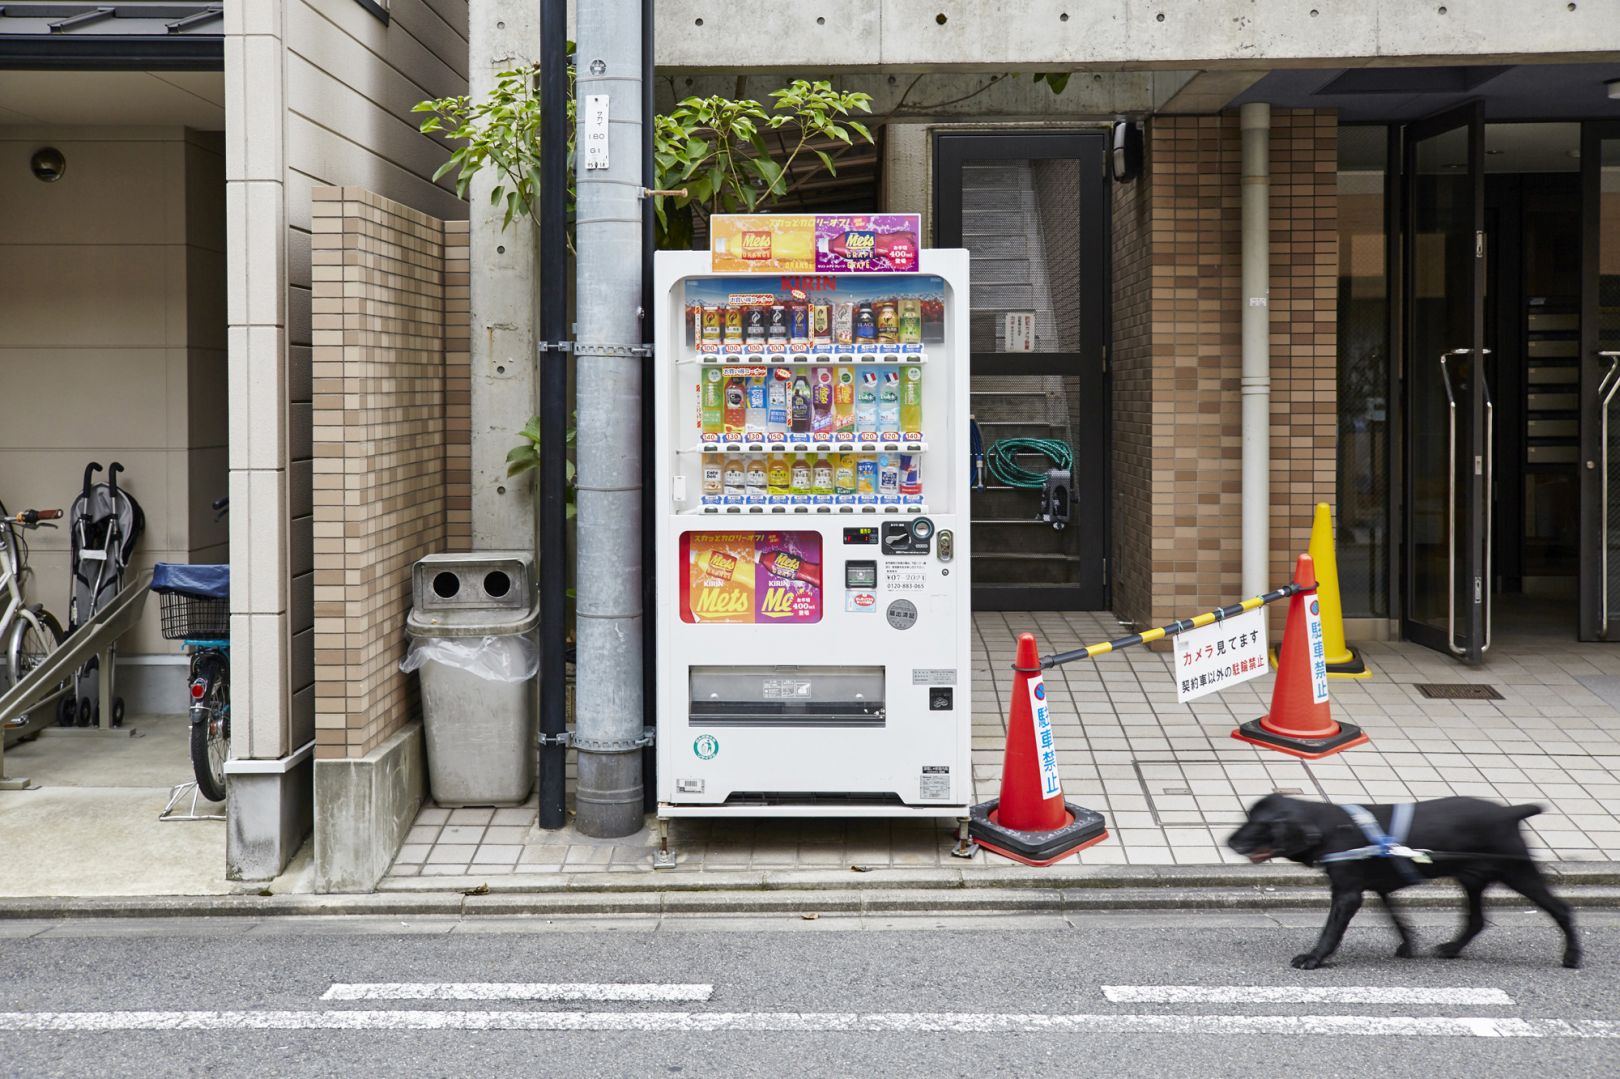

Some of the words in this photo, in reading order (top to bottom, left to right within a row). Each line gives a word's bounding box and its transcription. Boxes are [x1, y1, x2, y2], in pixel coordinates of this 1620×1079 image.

[743, 234, 772, 249] Mets
[846, 234, 875, 249] Mets
[847, 261, 871, 269] GRAPE
[780, 276, 837, 292] KIRIN
[775, 553, 800, 571] Mets
[697, 588, 749, 613] Mets
[1184, 629, 1259, 667] カメラ見てます
[1311, 621, 1328, 699] 駐車禁止
[1037, 706, 1060, 795] 駐車禁止
